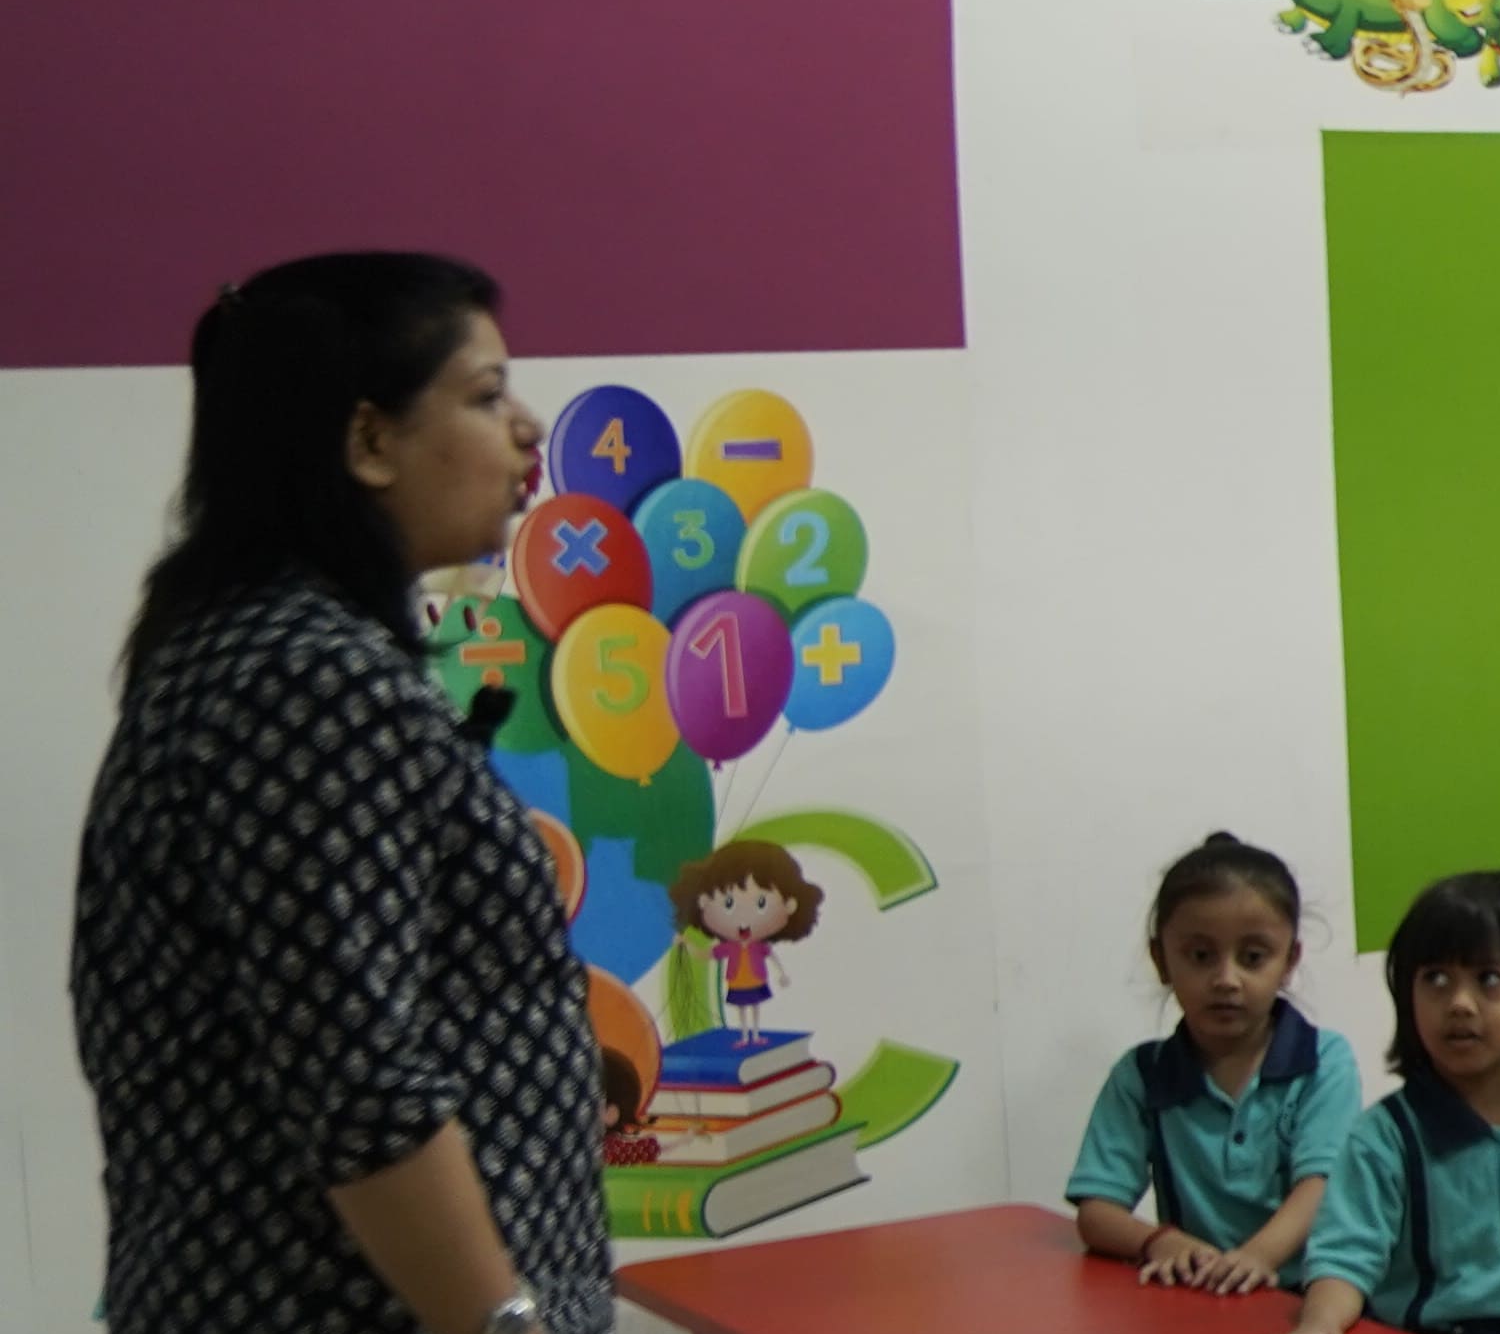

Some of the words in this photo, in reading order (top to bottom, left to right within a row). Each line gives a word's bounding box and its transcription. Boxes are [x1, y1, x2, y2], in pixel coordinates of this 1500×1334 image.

[591, 418, 631, 474] 4
[672, 509, 716, 570] 3
[777, 510, 830, 587] 2
[591, 633, 650, 716] 5
[689, 610, 749, 719] 1
